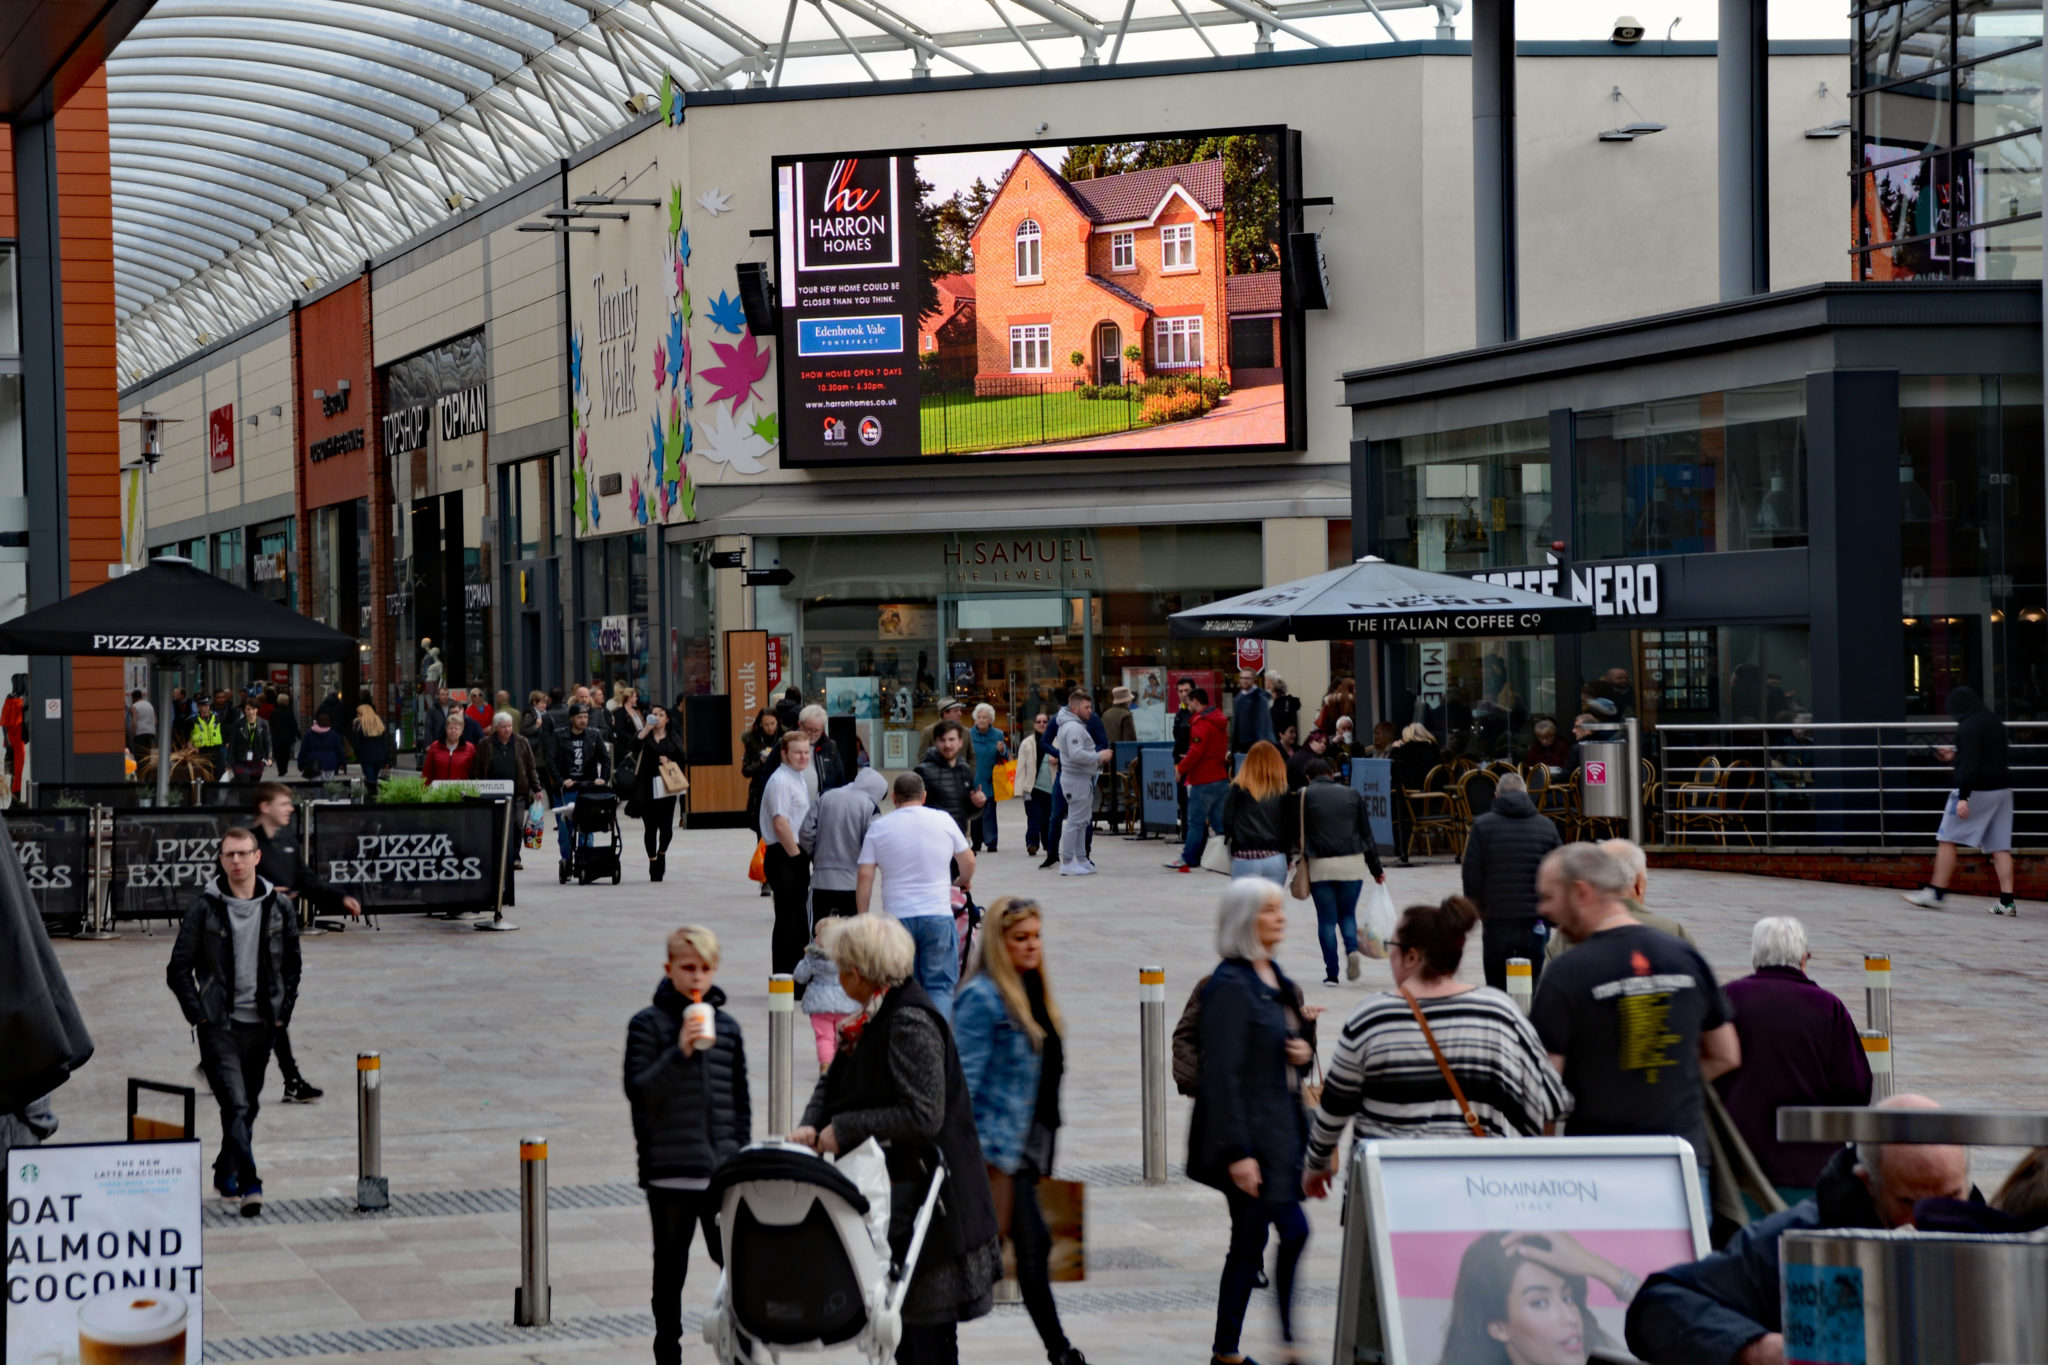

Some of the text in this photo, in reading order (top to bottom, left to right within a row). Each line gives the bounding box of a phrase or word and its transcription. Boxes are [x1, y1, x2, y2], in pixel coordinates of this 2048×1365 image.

[810, 215, 885, 238] HARRON
[824, 238, 872, 253] HOMES
[798, 282, 900, 295] YOUR NEW HOME COULD BE
[592, 269, 638, 352] Trinity
[802, 295, 896, 307] CLOSER THAN YOU THINK.
[815, 323, 886, 338] Edenbrook Vale
[822, 338, 879, 346] PONTEFRACT
[600, 339, 638, 420] Walk
[800, 368, 903, 380] SHOW HOMES OPEN 7 DAYS
[437, 384, 486, 441] TOPMAN
[805, 398, 897, 409] www.harronhomes.co.uk
[382, 405, 424, 456] TOPSHOP
[944, 538, 1093, 565] H.SAMUEL
[957, 570, 980, 582] HE
[465, 583, 491, 609] TOPMAN
[1571, 563, 1658, 616] NERO
[1348, 619, 1377, 632] THE
[1383, 616, 1448, 631] ITALIAN
[1454, 615, 1515, 630] COFFEE
[738, 661, 756, 710] walk
[1423, 648, 1443, 705] MUE
[1147, 782, 1174, 801] NERO
[1362, 795, 1387, 818] ERO
[357, 834, 454, 859] PIZZA
[126, 863, 217, 888] EXPR
[329, 857, 482, 884] EXPRESS
[94, 1167, 182, 1179] LATTE MACCHIATO
[116, 1158, 160, 1168] THE NEW
[8, 1194, 83, 1226] OAT
[1514, 1201, 1553, 1212] ITALY
[7, 1228, 183, 1266] ALMOND
[7, 1265, 203, 1305] COCONUT
